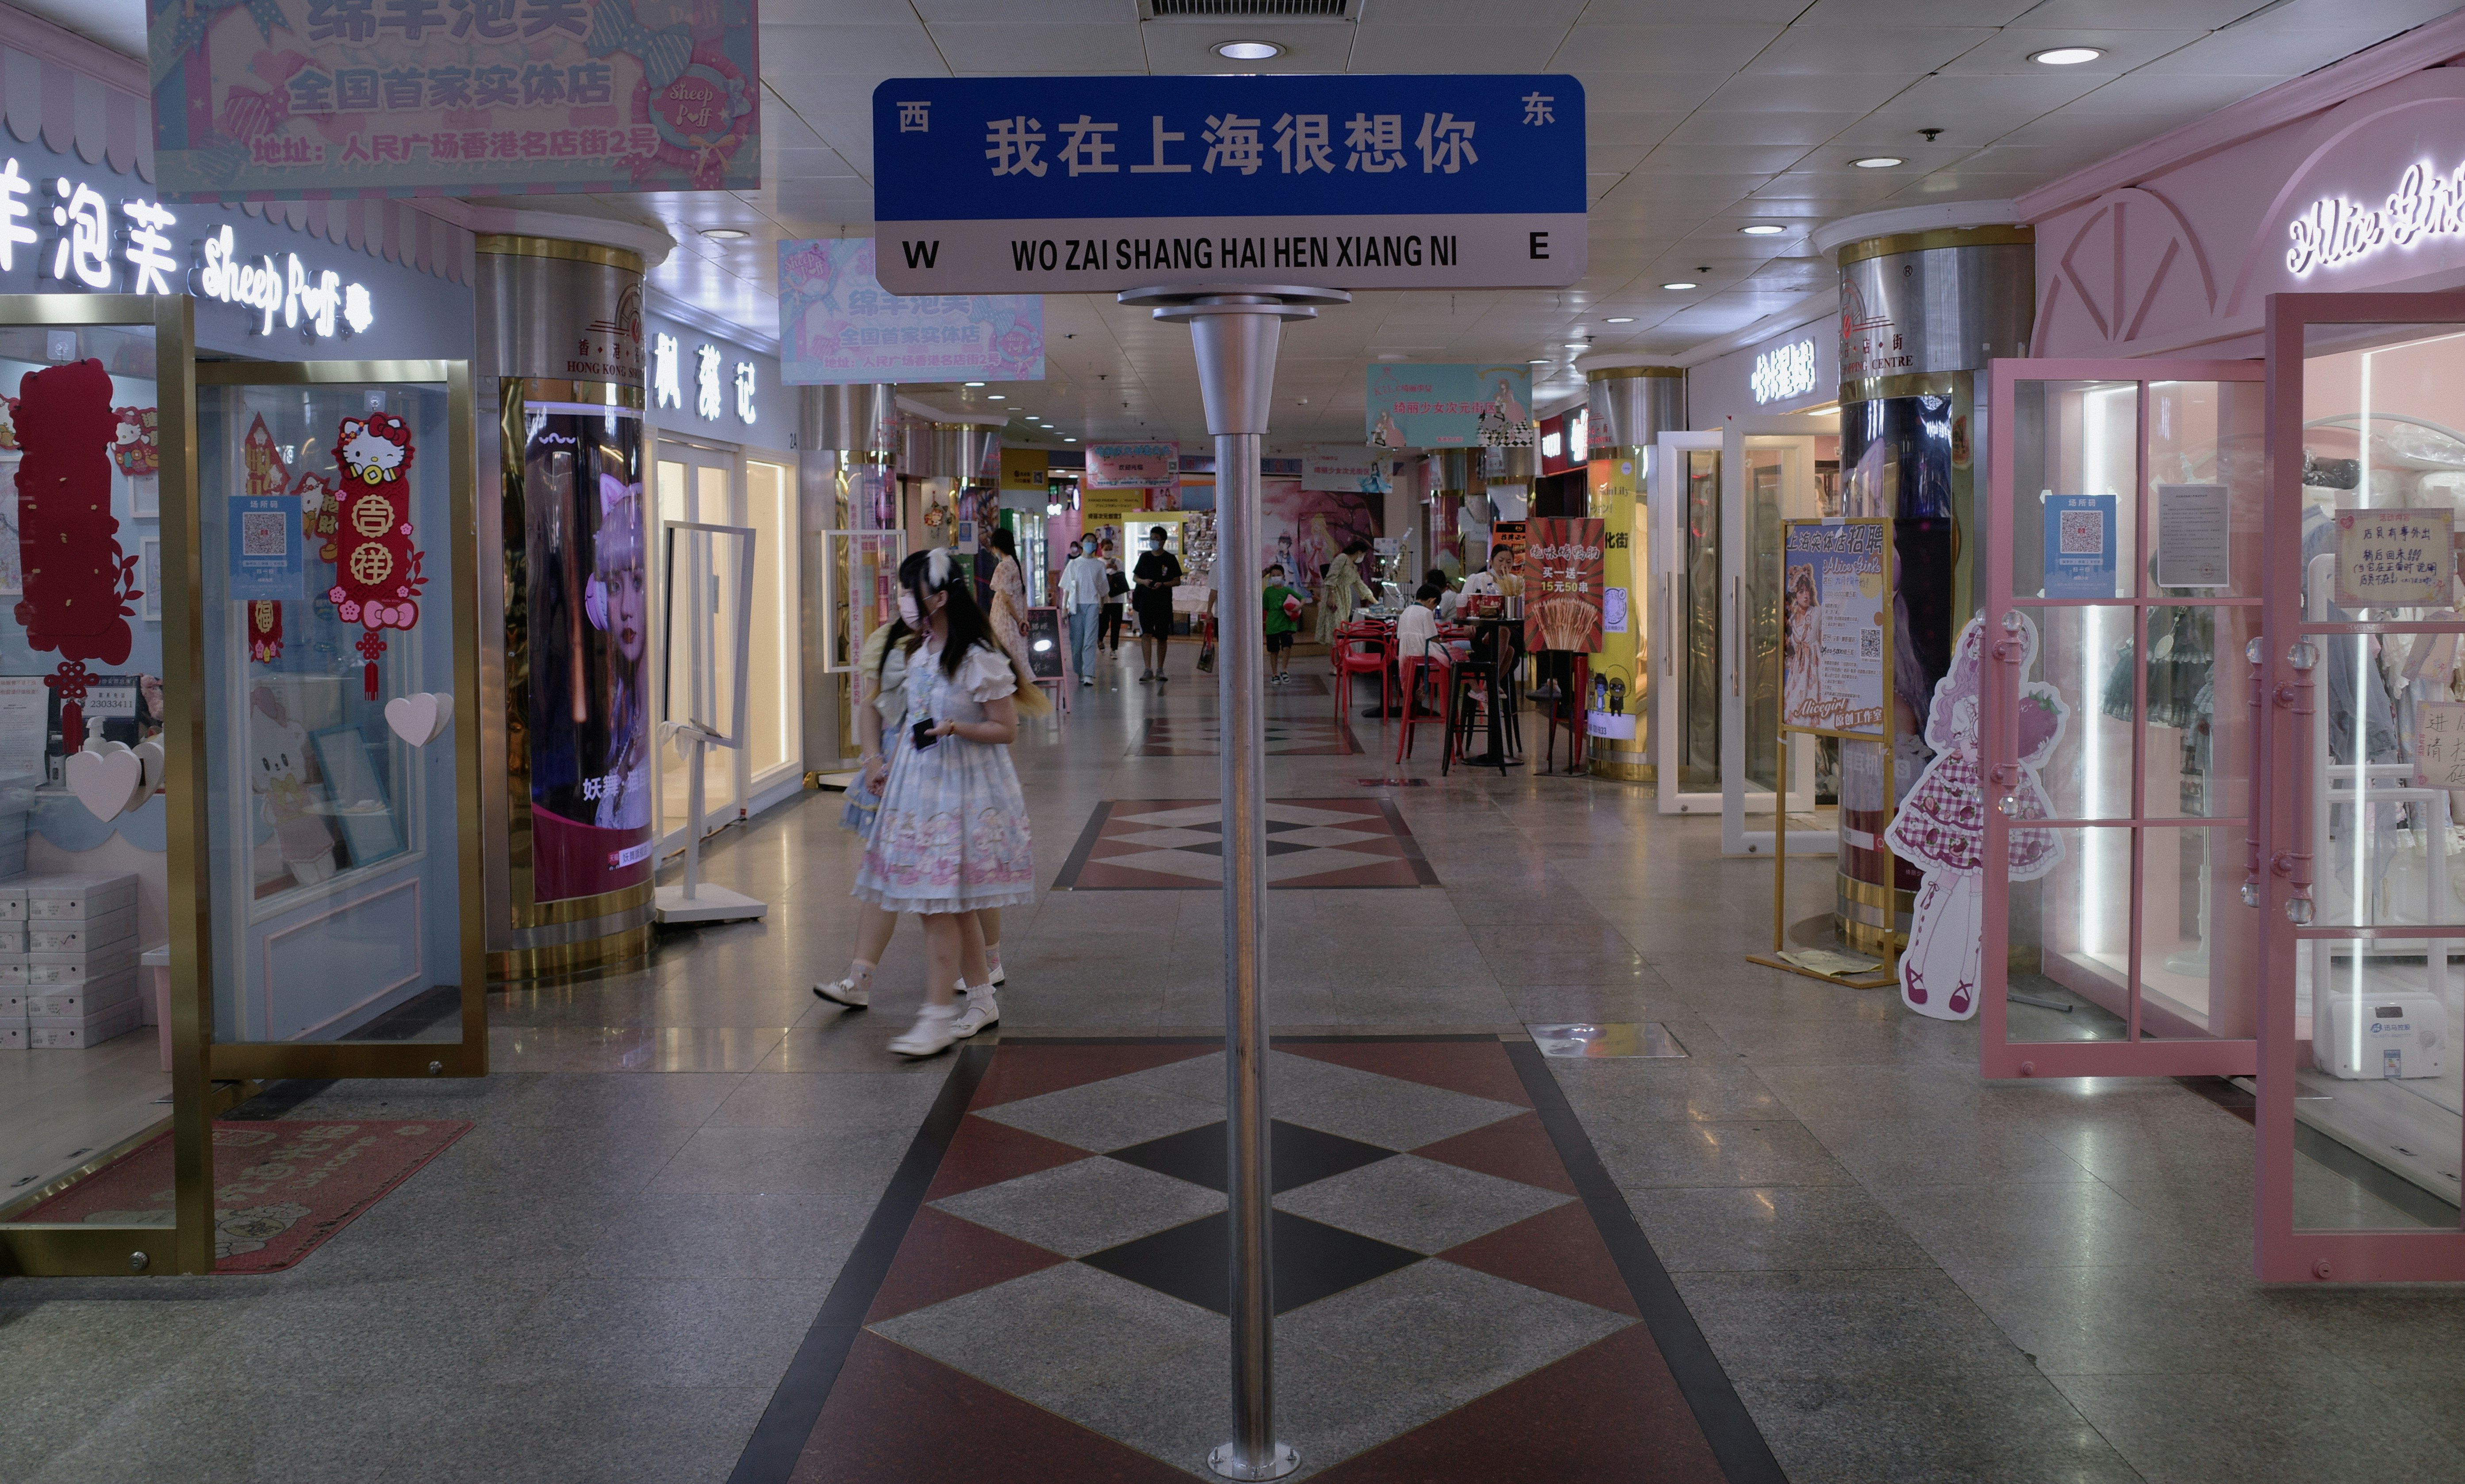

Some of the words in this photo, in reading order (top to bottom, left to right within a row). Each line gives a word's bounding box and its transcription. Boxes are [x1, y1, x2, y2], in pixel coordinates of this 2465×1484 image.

[288, 62, 612, 111] 全国首家实体店
[669, 81, 714, 101] Sheep
[896, 101, 931, 133] 西
[1521, 91, 1556, 127] 东
[253, 127, 658, 163] 地址：人民广场香港名店街2号
[985, 112, 1479, 178] 我在上海很想你
[2286, 197, 2386, 273] Alice
[902, 241, 940, 268] W
[1012, 240, 1057, 271] WO
[1065, 239, 1108, 270] ZAI
[1116, 237, 1212, 270] SHANG
[1221, 237, 1265, 268] HAI
[1274, 236, 1328, 267] HEN
[1336, 235, 1422, 266] XIANG
[1430, 235, 1457, 266] NI
[1529, 232, 1549, 260] E
[202, 224, 282, 336] Sheep
[841, 326, 980, 346] 全国首家实体店
[1893, 334, 1902, 351] 街
[567, 360, 600, 374] HONG
[603, 364, 626, 377] KONG
[1872, 355, 1913, 370] CENTRE
[1394, 401, 1497, 414] 绮丽少女次元街区
[250, 500, 278, 509] 场所码
[2068, 499, 2096, 507] 场所码
[1605, 532, 1629, 548] 化街
[1786, 523, 1884, 554] 上海实体店招聘
[2363, 525, 2430, 541] 店员有事外出
[1529, 544, 1601, 560] 绝味烤鸭肠
[1542, 566, 1587, 579] 买一送一
[1822, 556, 1852, 573] Alice
[1541, 581, 1589, 594] 15元50串
[1836, 709, 1883, 727] 原创工作室
